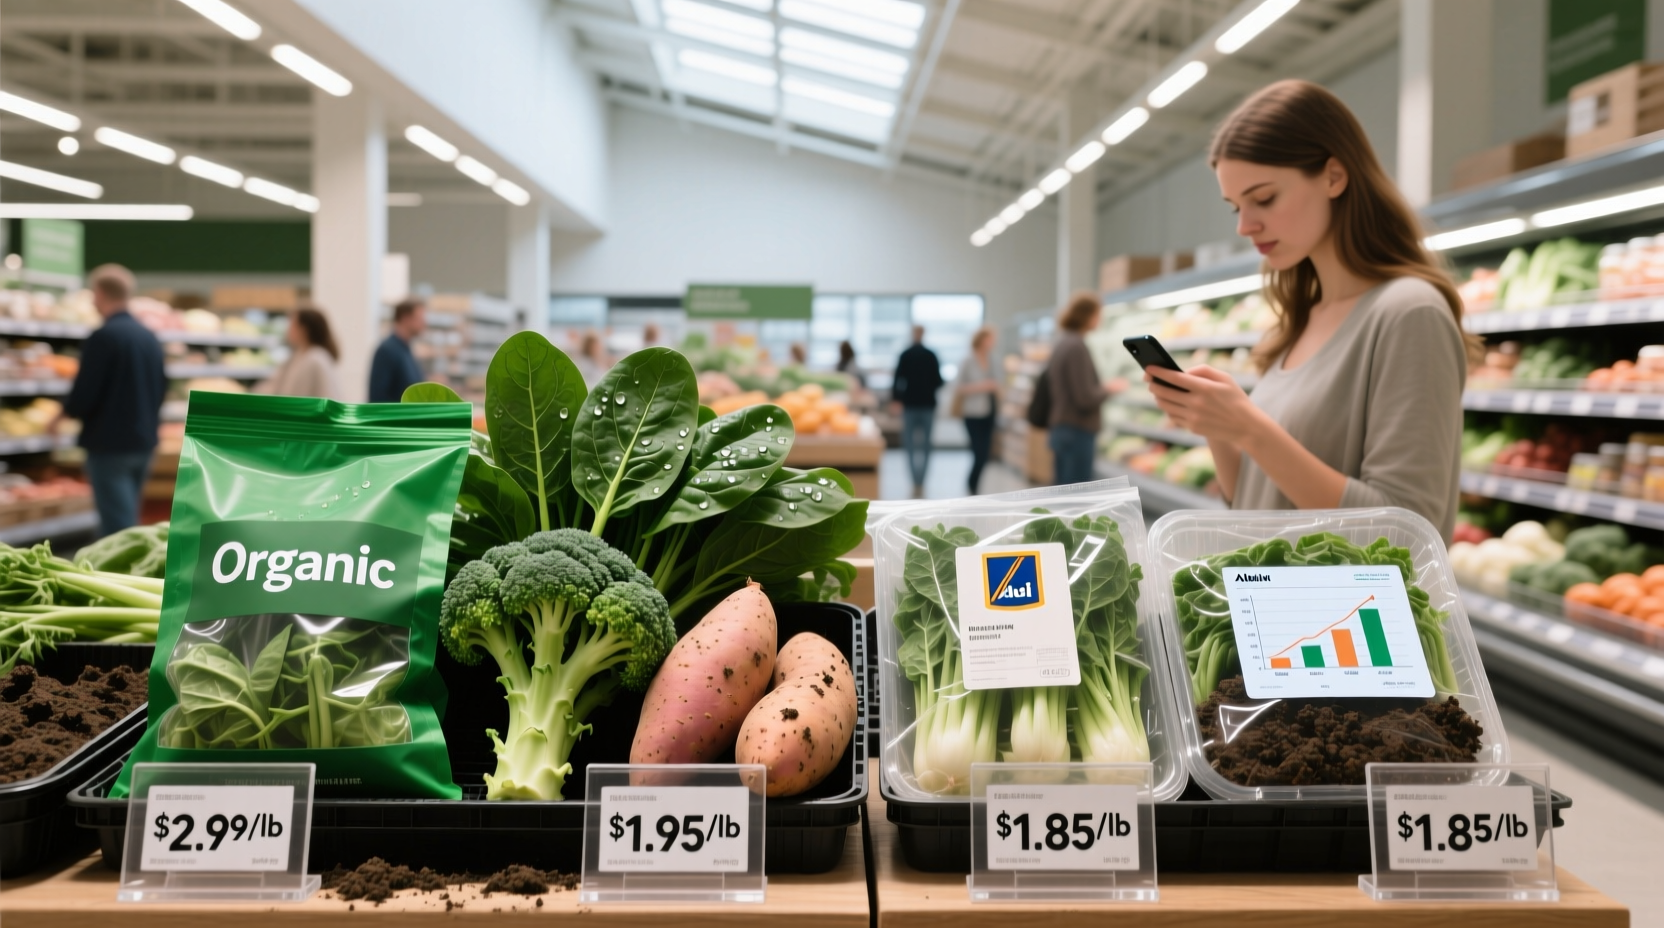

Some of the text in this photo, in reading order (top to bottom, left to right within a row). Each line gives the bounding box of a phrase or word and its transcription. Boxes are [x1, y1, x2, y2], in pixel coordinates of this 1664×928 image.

[211, 541, 396, 593] Organic
[153, 811, 283, 852] $2.99/lb
[609, 811, 741, 852] $1.95/lb
[996, 810, 1131, 851] $1.85/lb
[1397, 811, 1529, 852] $1.85/lb
